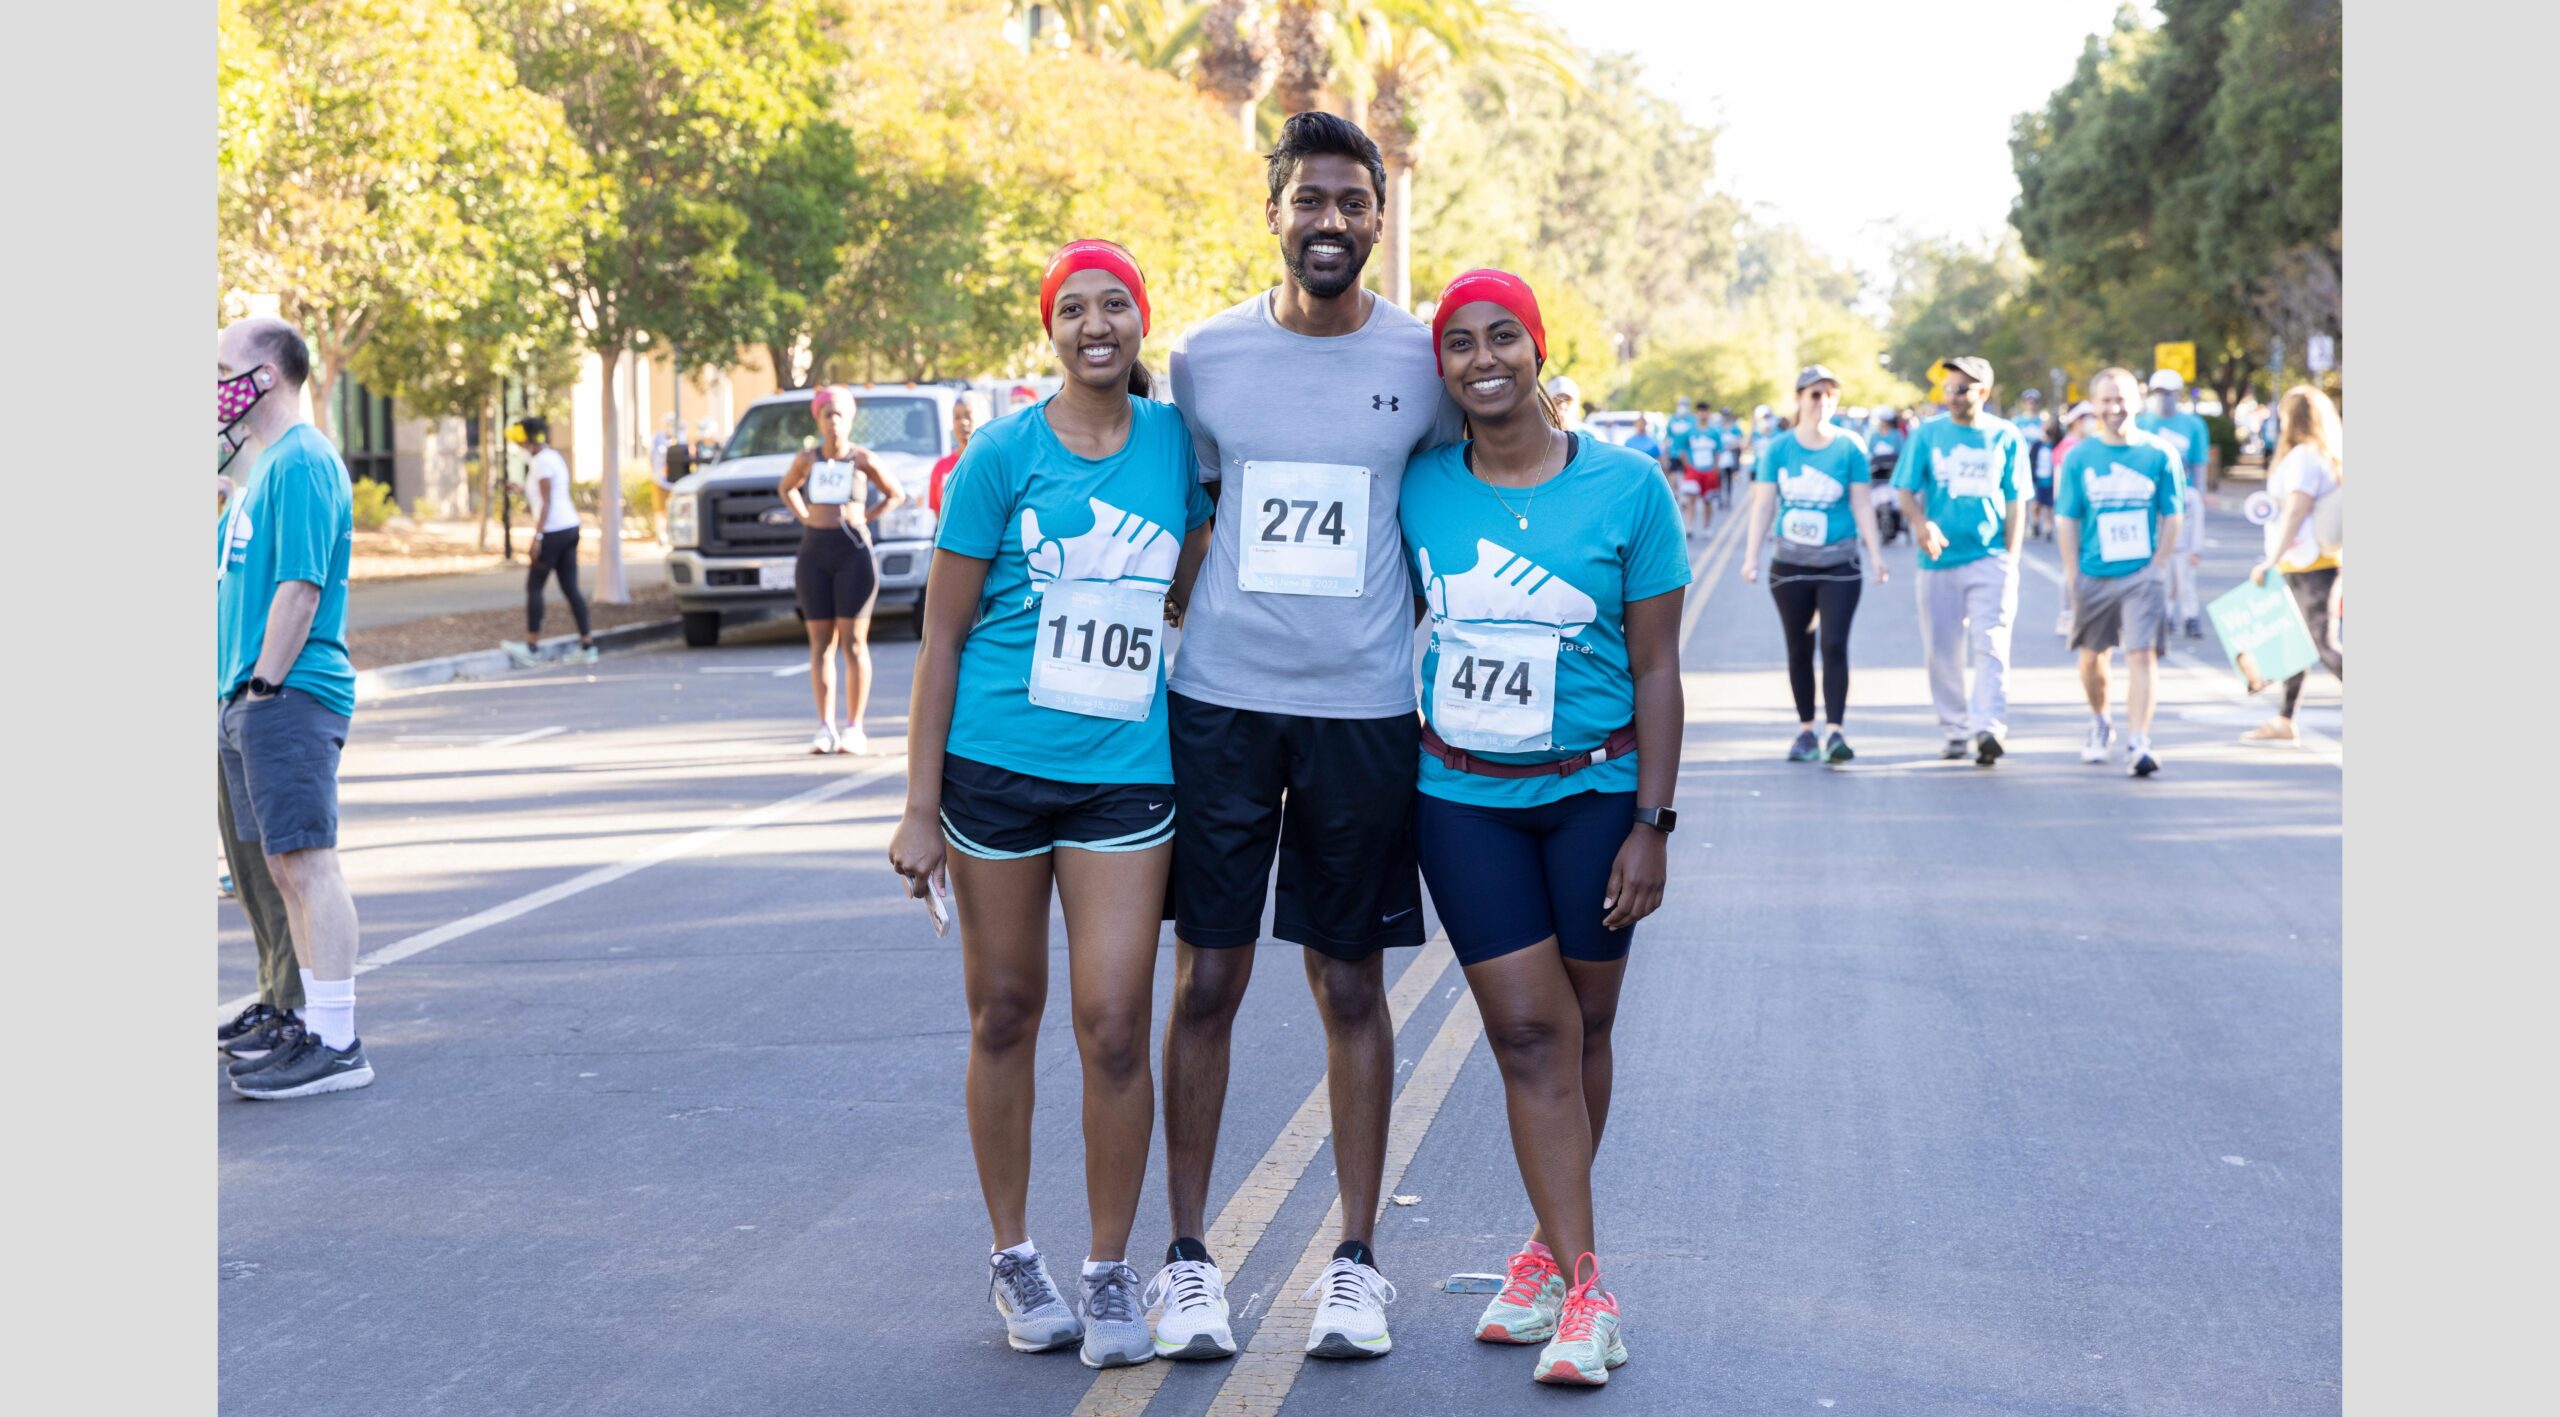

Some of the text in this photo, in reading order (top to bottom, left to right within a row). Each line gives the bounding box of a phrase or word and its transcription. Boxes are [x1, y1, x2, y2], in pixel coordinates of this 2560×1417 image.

[1261, 498, 1345, 545] 274
[1048, 615, 1153, 671] 1105
[1560, 641, 1594, 655] rate!
[1452, 655, 1532, 705] 474
